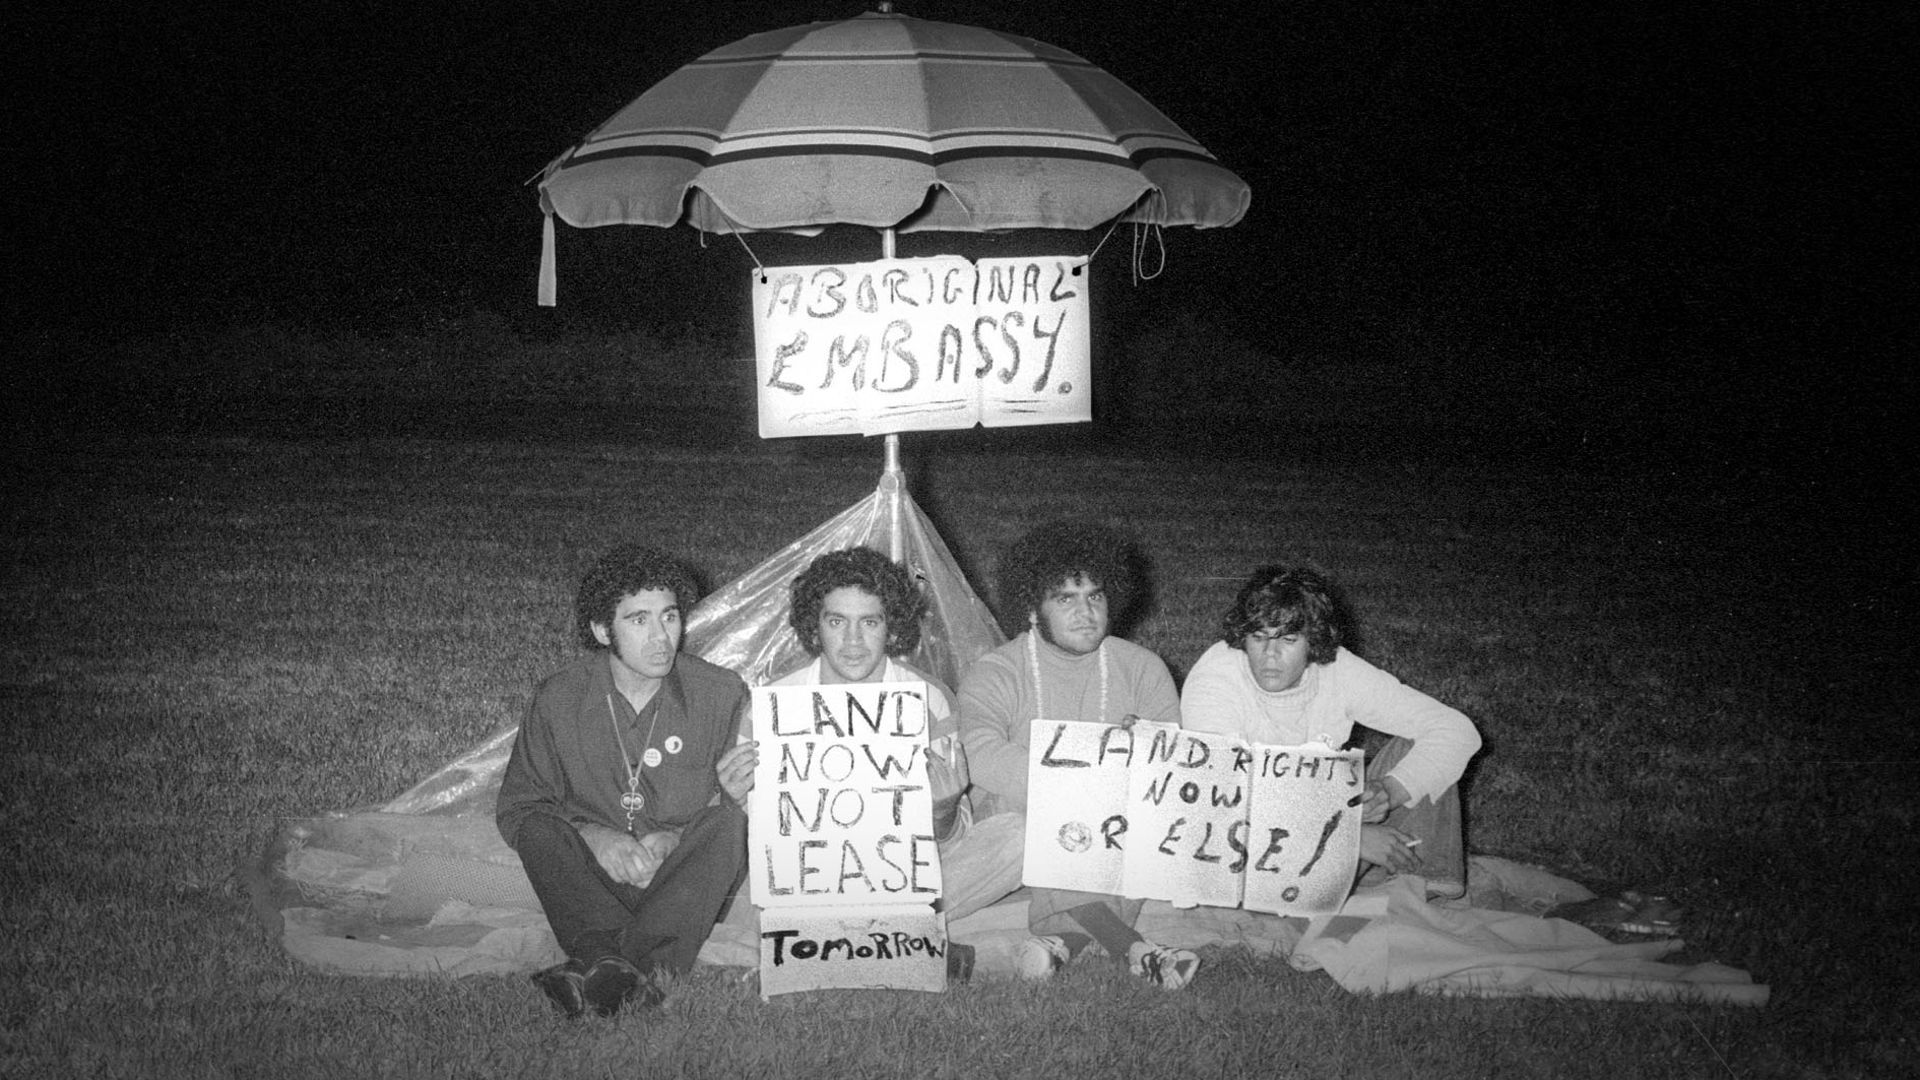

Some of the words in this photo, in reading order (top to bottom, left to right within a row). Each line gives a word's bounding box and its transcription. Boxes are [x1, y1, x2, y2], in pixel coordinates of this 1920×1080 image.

[766, 263, 1076, 318] ABORIGINAL
[766, 309, 1072, 394] EMBASSY.
[769, 691, 926, 737] LAND
[778, 742, 920, 784] NOW
[1233, 747, 1359, 786] RIGHTS
[778, 785, 923, 836] NOT
[1142, 771, 1241, 808] NOW
[765, 834, 940, 895] LEASE
[1058, 815, 1129, 853] OR
[1158, 810, 1342, 902] ELSE!
